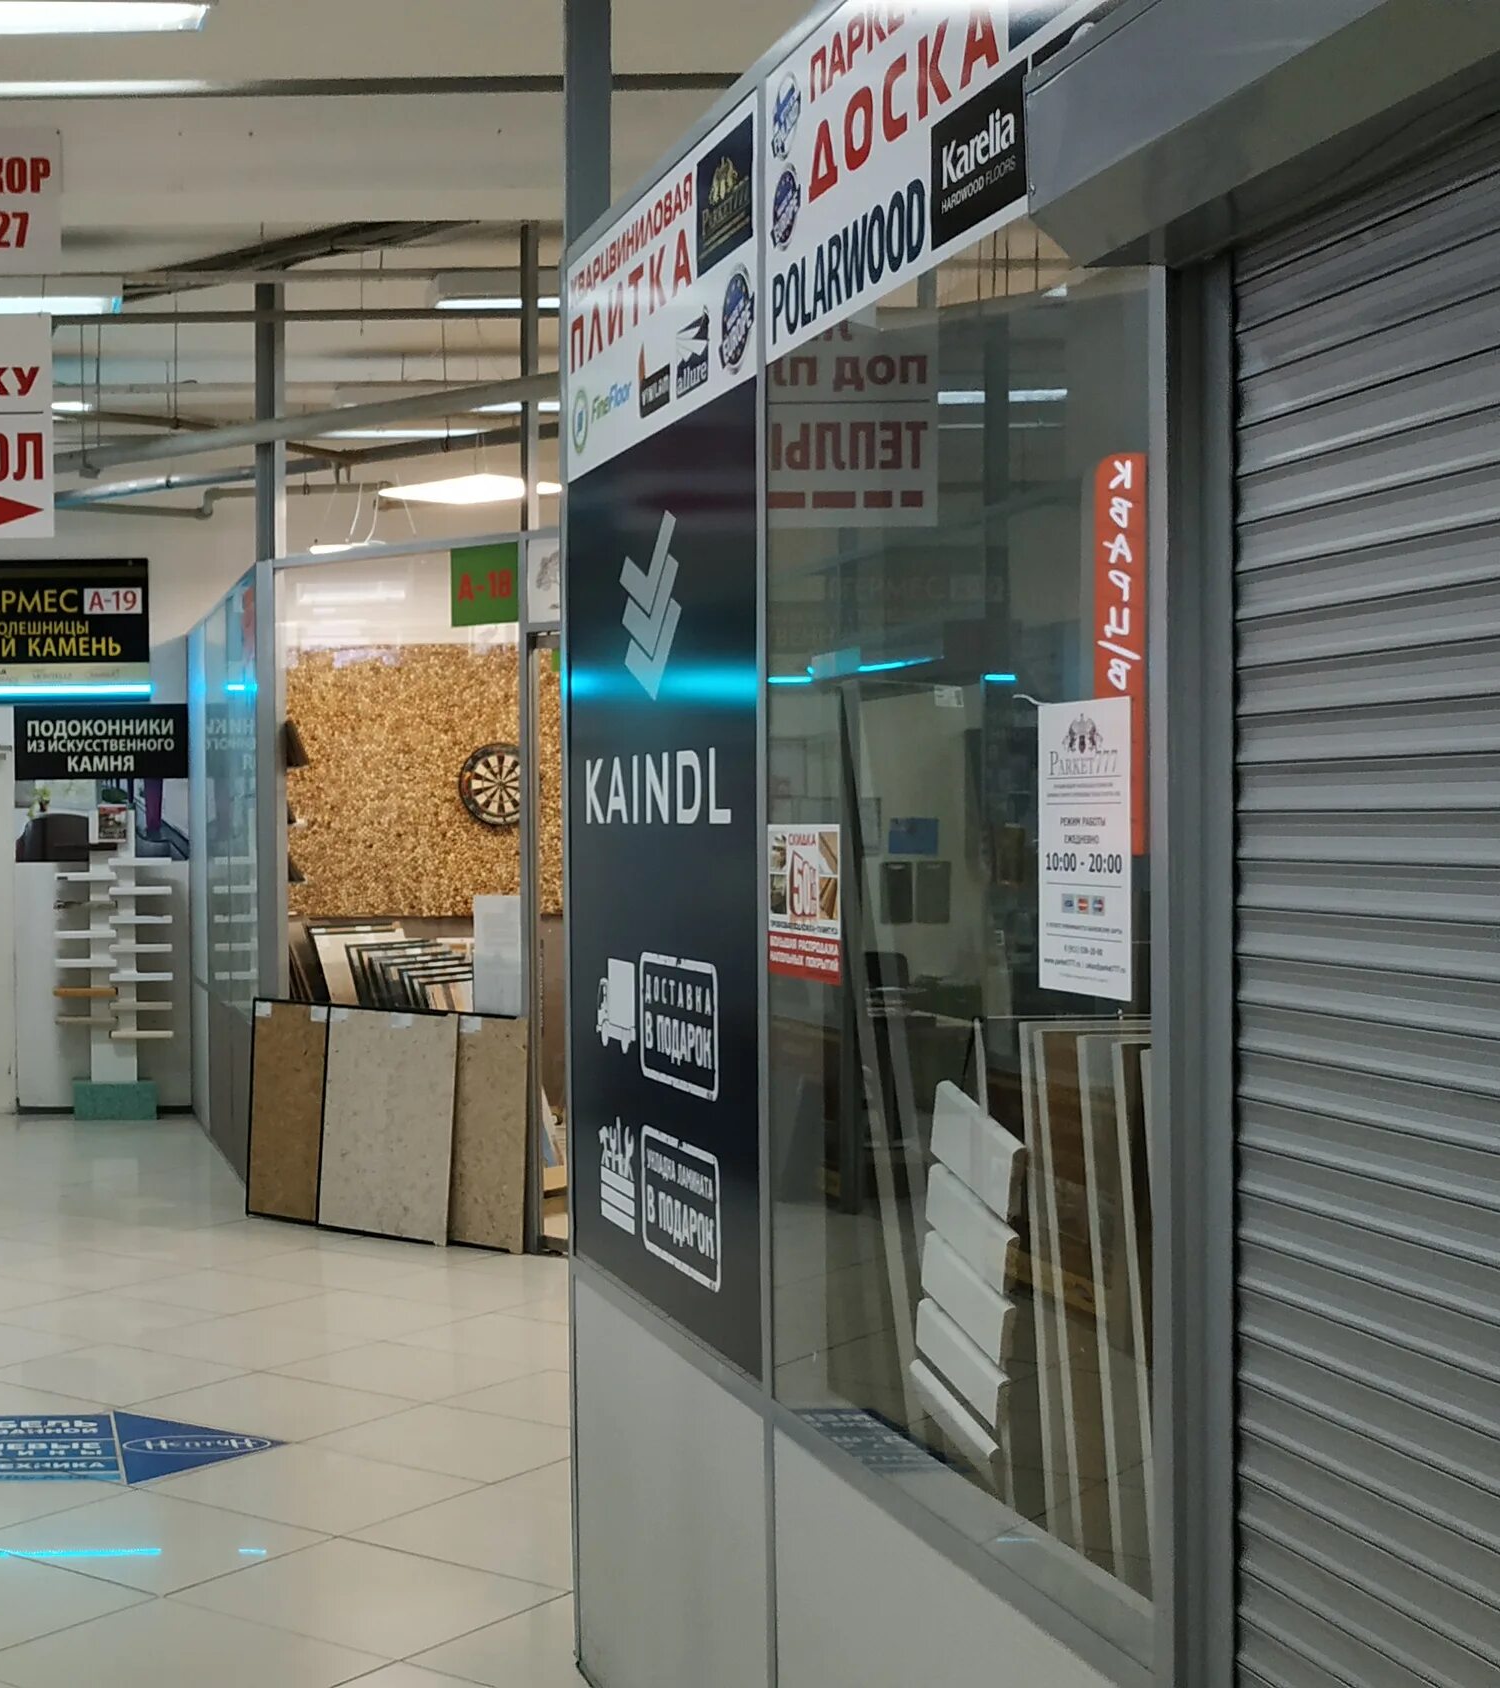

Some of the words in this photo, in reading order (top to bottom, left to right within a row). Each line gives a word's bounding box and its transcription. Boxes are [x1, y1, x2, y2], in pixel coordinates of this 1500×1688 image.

[808, 0, 1000, 203] ДОСКА
[941, 108, 1016, 191] Karelia
[941, 174, 985, 215] HARDWOOD
[985, 154, 1017, 187] FLOORS
[772, 178, 926, 345] POLARWOOD
[570, 228, 693, 376] ПЛИТКА
[676, 360, 708, 394] allure
[89, 590, 138, 612] А-19
[28, 635, 122, 658] КАМЕНЬ
[27, 719, 174, 740] ПОДОКОННИКИ
[27, 740, 46, 753] ИЗ
[48, 738, 175, 753] ИСКУССТВЕННОГО
[67, 755, 135, 773] КАМНЯ
[585, 747, 732, 826] KAINDL
[1045, 852, 1077, 872] 10:00
[1088, 853, 1123, 874] 20:00
[644, 973, 712, 1017] ДОСТАВКА
[644, 1011, 654, 1050] В
[656, 1014, 713, 1070] ПОДАРОК
[646, 1183, 656, 1224] В
[657, 1190, 716, 1260] ПОДАРОК
